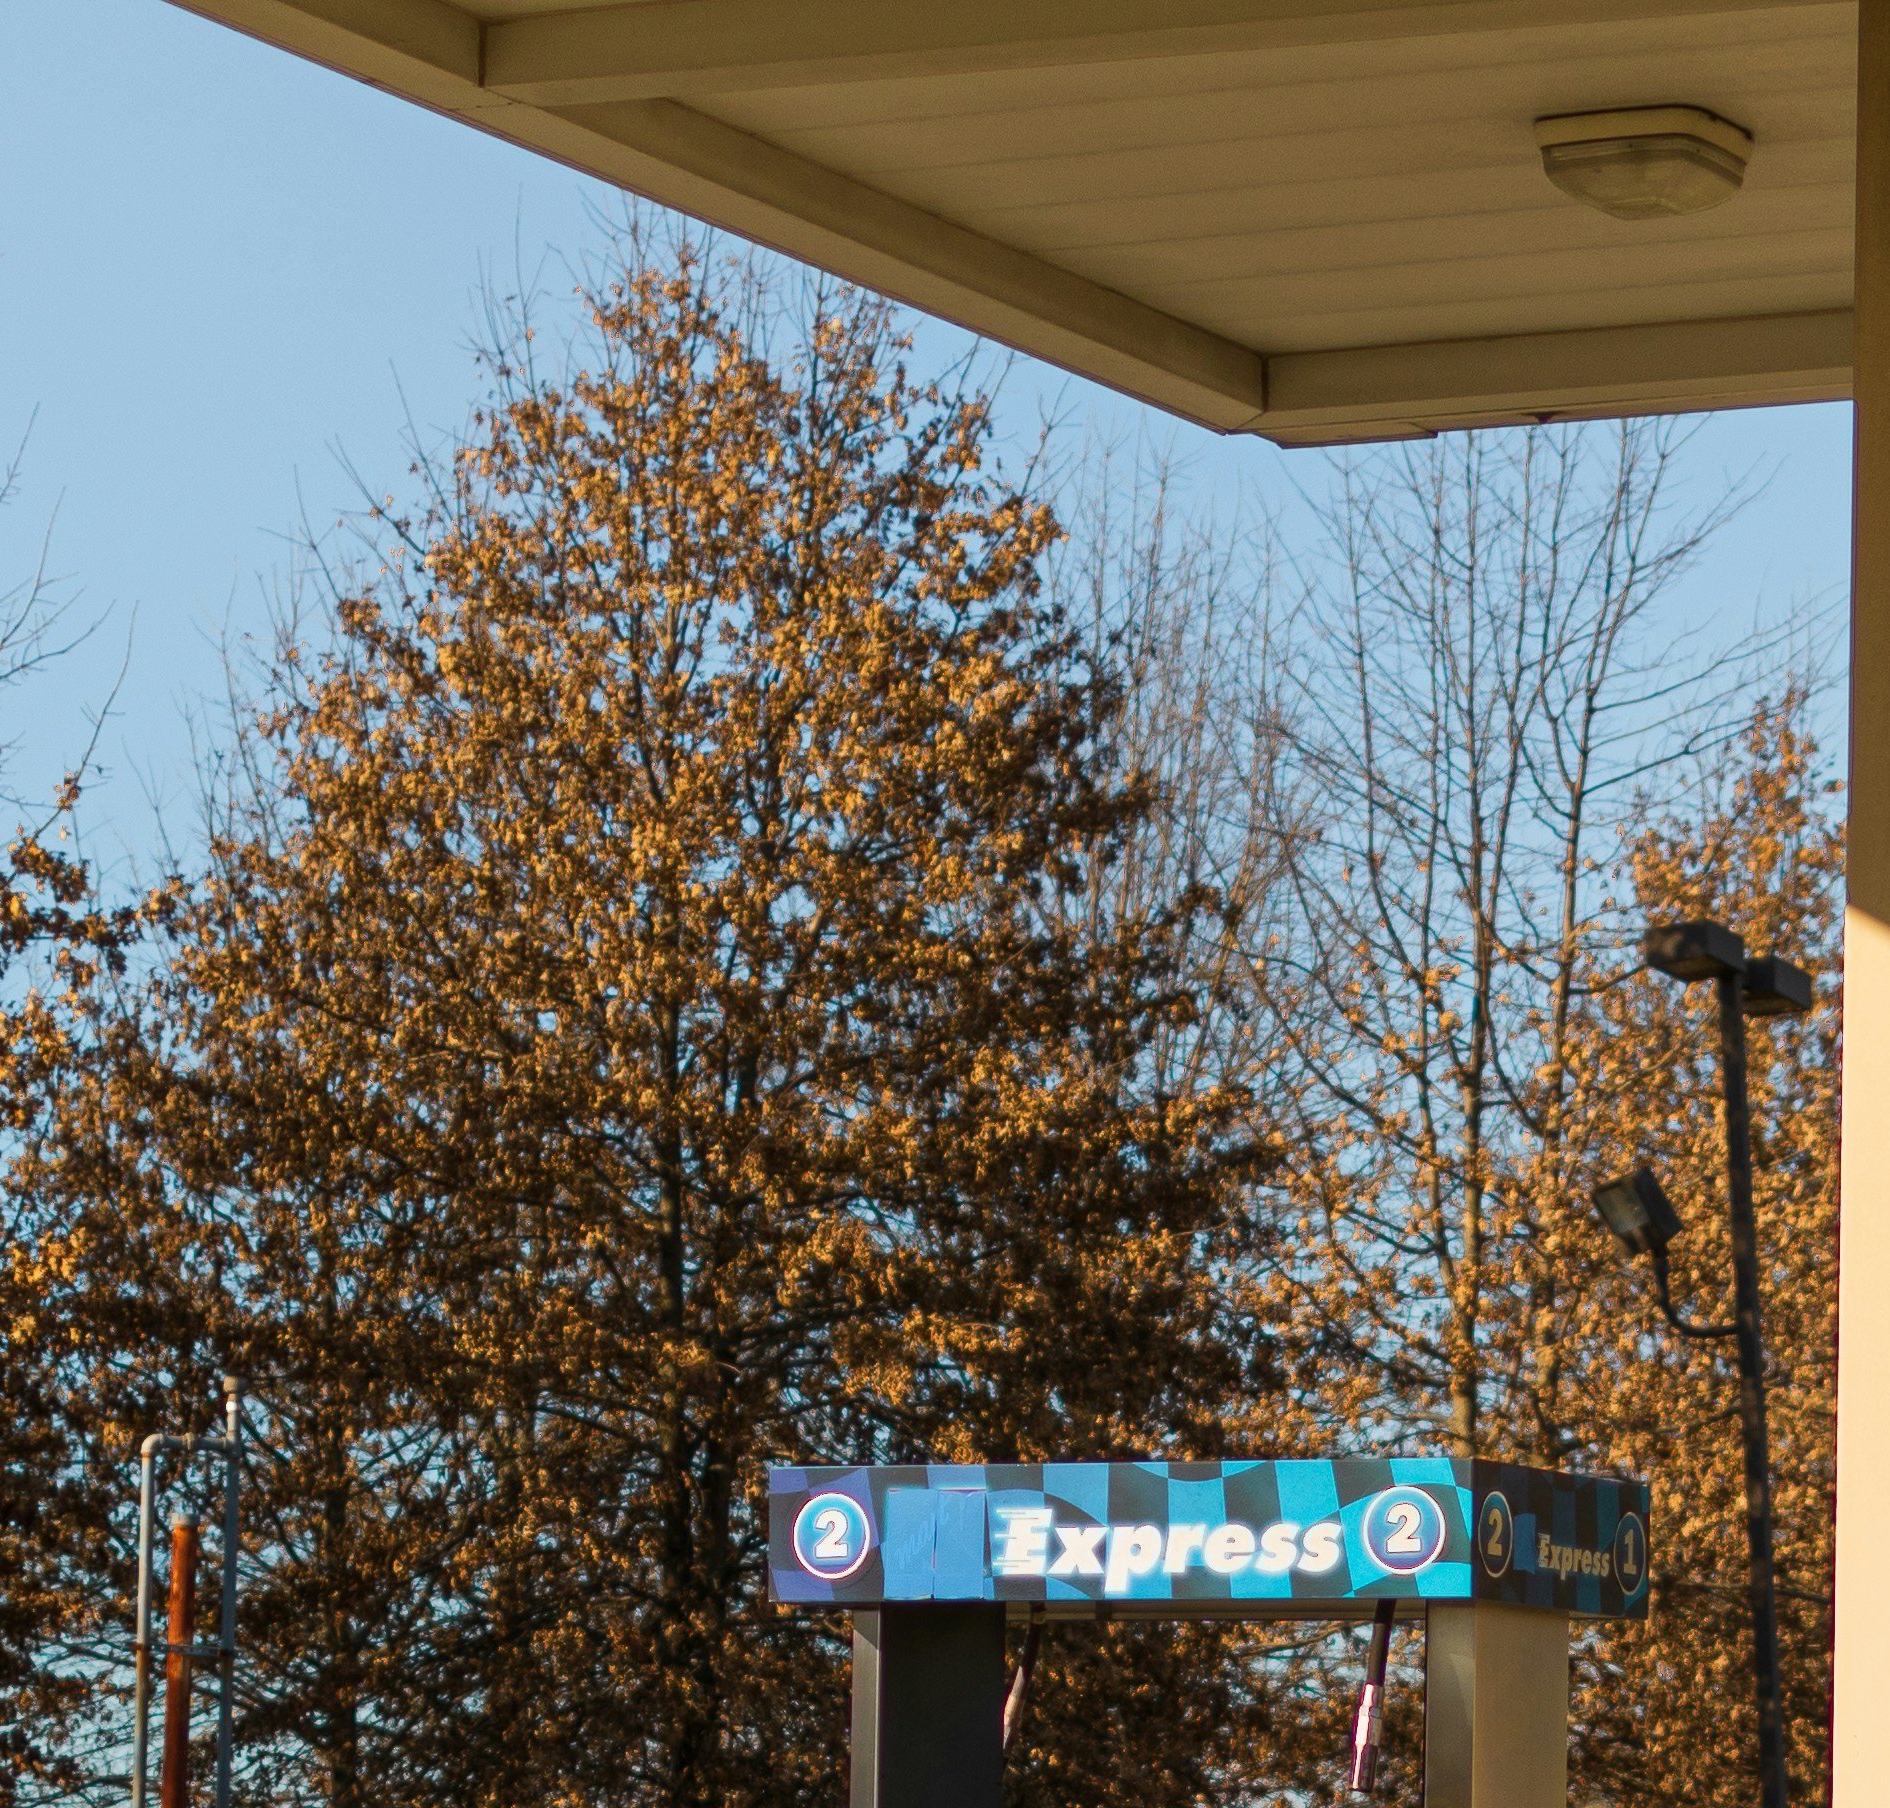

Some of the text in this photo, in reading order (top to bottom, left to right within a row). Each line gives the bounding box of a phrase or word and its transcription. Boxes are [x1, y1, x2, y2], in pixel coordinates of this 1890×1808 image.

[814, 1510, 849, 1558] 2
[996, 1507, 1344, 1592] Express
[1386, 1503, 1422, 1553] 2
[1487, 1508, 1503, 1557] 2
[1623, 1528, 1637, 1576] 1
[1538, 1532, 1610, 1580] Express
